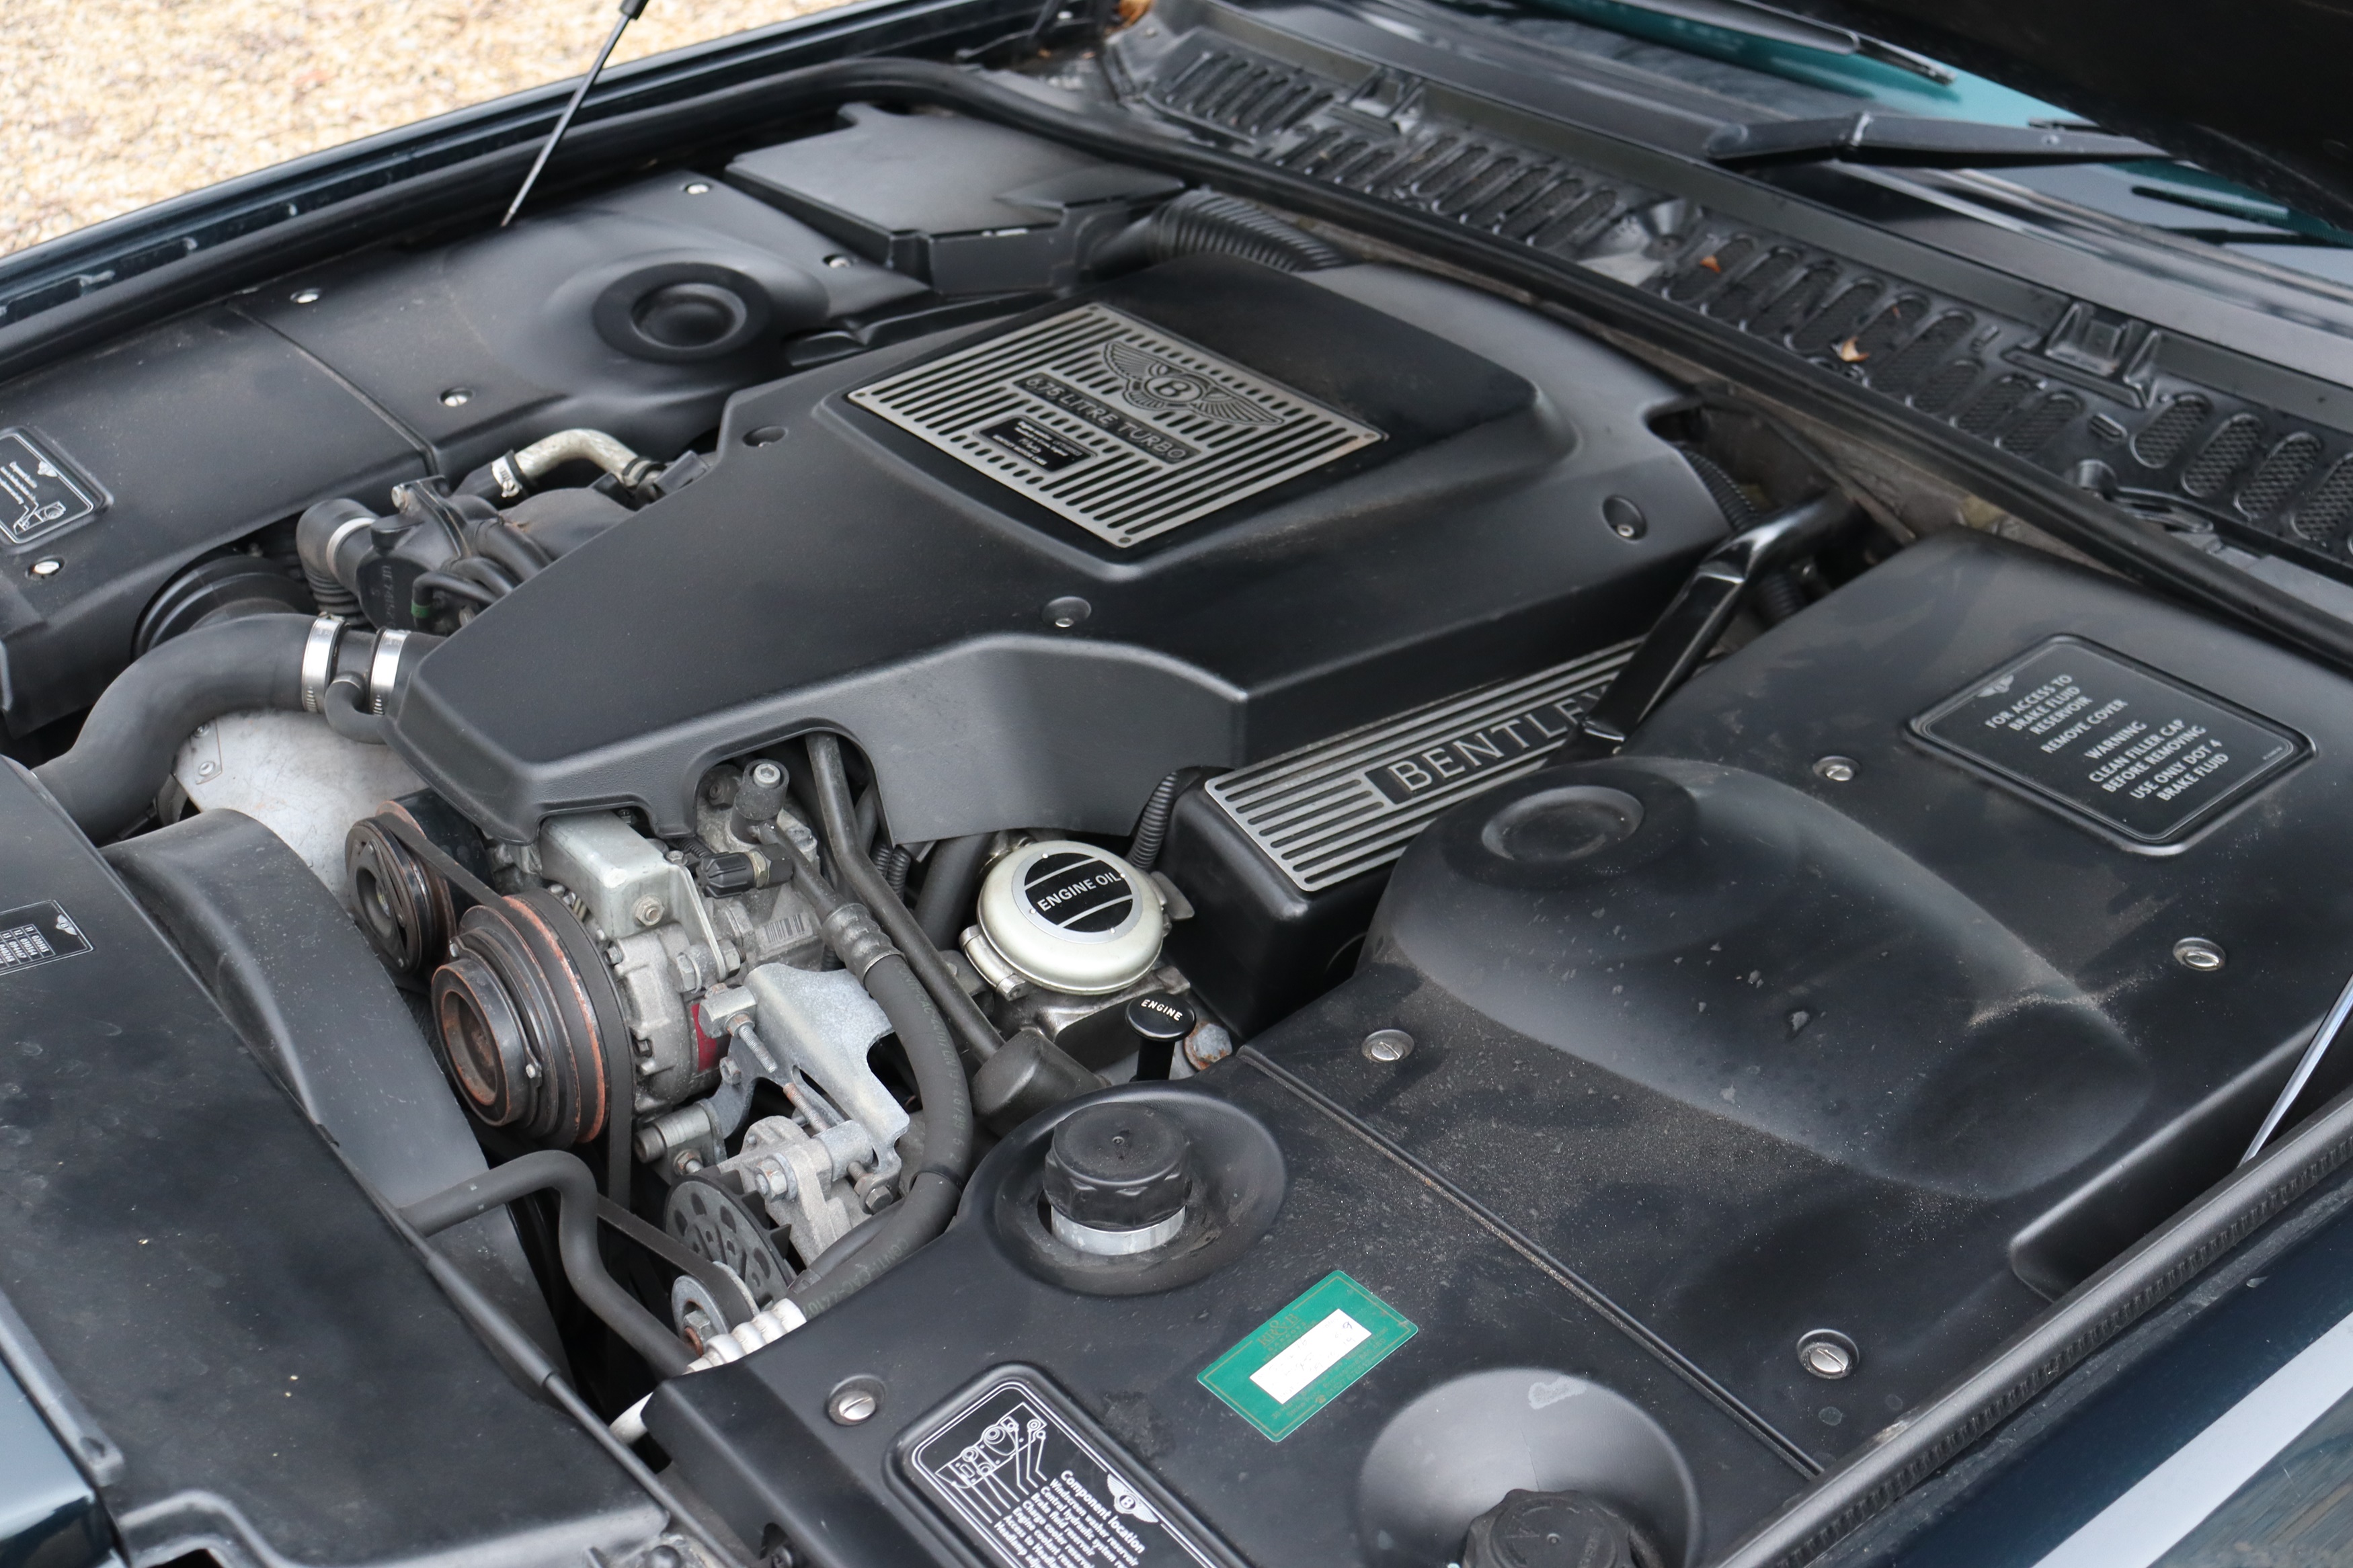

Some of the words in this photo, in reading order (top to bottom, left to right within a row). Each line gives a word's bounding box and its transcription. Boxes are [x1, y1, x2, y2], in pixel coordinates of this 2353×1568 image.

[1060, 393, 1119, 424] LITRE
[1117, 421, 1186, 458] TURBO
[1985, 711, 2014, 729] FOR
[2011, 685, 2056, 714] ACCESS
[2051, 674, 2073, 687] TO
[2008, 705, 2050, 731] BRAKE
[2044, 686, 2081, 708] FLUID
[2030, 696, 2093, 735] RESERVOIR
[2040, 722, 2091, 753] REMOVE
[2087, 699, 2128, 725] COVER
[2084, 721, 2147, 759] WARNING
[2089, 756, 2130, 782] CLEAN
[2124, 734, 2165, 759] FILLER
[2159, 719, 2184, 736] CAP
[2102, 761, 2150, 792] BEFORE
[2144, 725, 2206, 765] REMOVING
[2130, 780, 2159, 798] USE
[2153, 761, 2187, 784] ONLY
[2182, 745, 2212, 765] DOT
[2209, 739, 2222, 747] 4
[2157, 773, 2199, 801] BRAKE
[2193, 753, 2229, 777] FLUID
[1037, 878, 1096, 912] ENGINE
[1095, 872, 1122, 886] OIL
[1141, 999, 1183, 1021] ENGINE
[994, 1520, 1028, 1555] Headlamp
[1002, 1514, 1027, 1538] Access
[1024, 1534, 1034, 1546] to
[1012, 1506, 1035, 1531] Engine
[1034, 1529, 1061, 1556] coolant
[1023, 1499, 1046, 1525] Charge
[1044, 1523, 1068, 1546] cooler
[1031, 1492, 1051, 1514] Brake
[1049, 1510, 1069, 1529] fluid
[1064, 1526, 1095, 1557] reservoir
[1040, 1486, 1068, 1512] Central
[1063, 1508, 1095, 1540] hydraulic
[1092, 1538, 1117, 1562] system
[1049, 1478, 1087, 1516] Windscreen
[1084, 1514, 1109, 1538] washer
[1107, 1536, 1139, 1567] reservoir
[1060, 1470, 1113, 1520] Component
[1108, 1515, 1145, 1554] location
